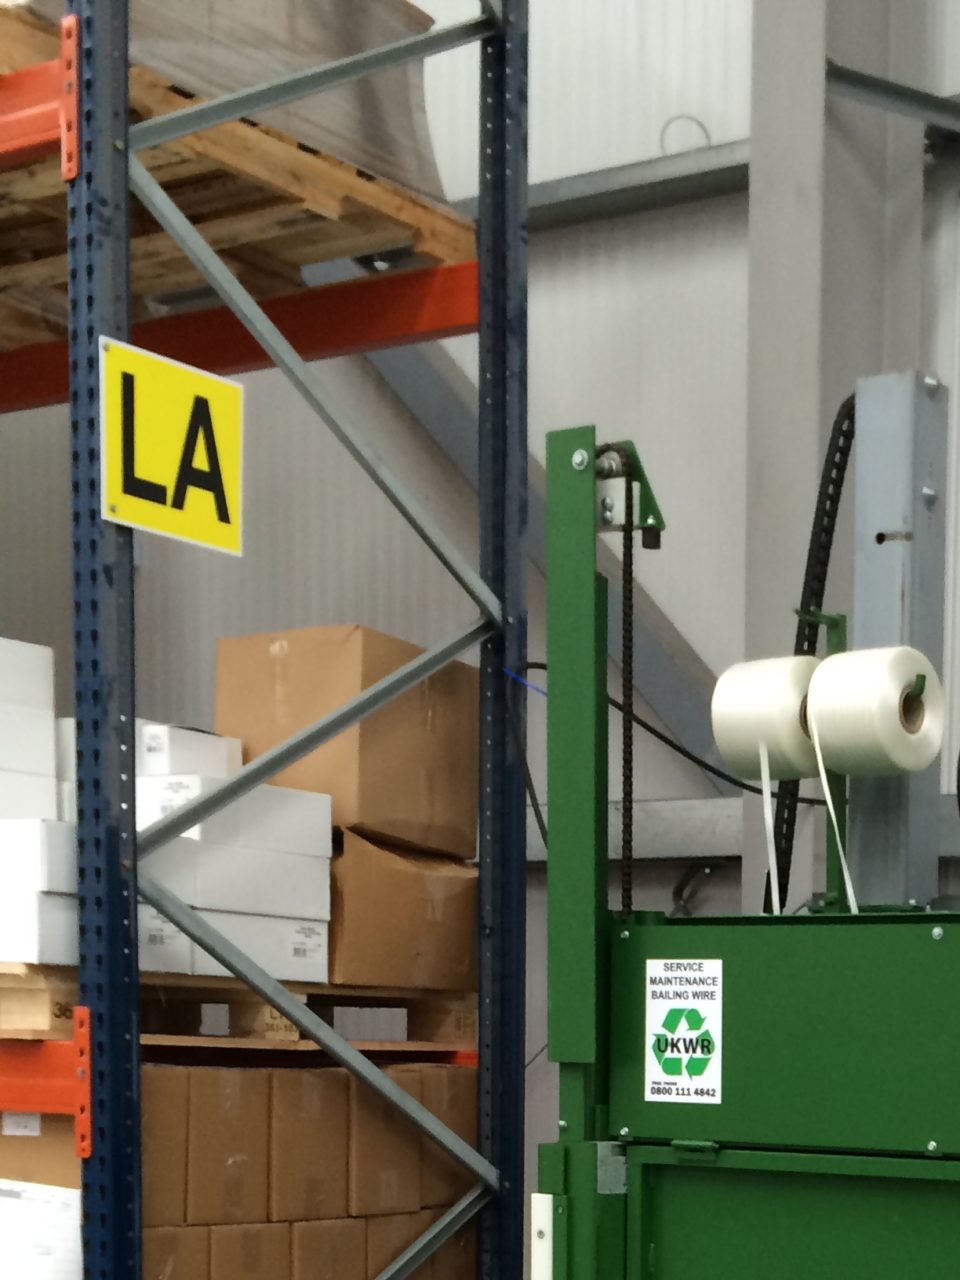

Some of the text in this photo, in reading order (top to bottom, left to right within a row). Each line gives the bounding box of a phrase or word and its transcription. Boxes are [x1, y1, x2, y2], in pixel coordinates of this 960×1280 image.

[121, 371, 231, 524] LA
[663, 962, 704, 972] SERVICE
[650, 977, 718, 987] MAINTENANCE
[651, 991, 716, 1001] BAILING WIRE
[657, 1038, 711, 1055] UKWR
[650, 1086, 717, 1097] 0800 111 4842
